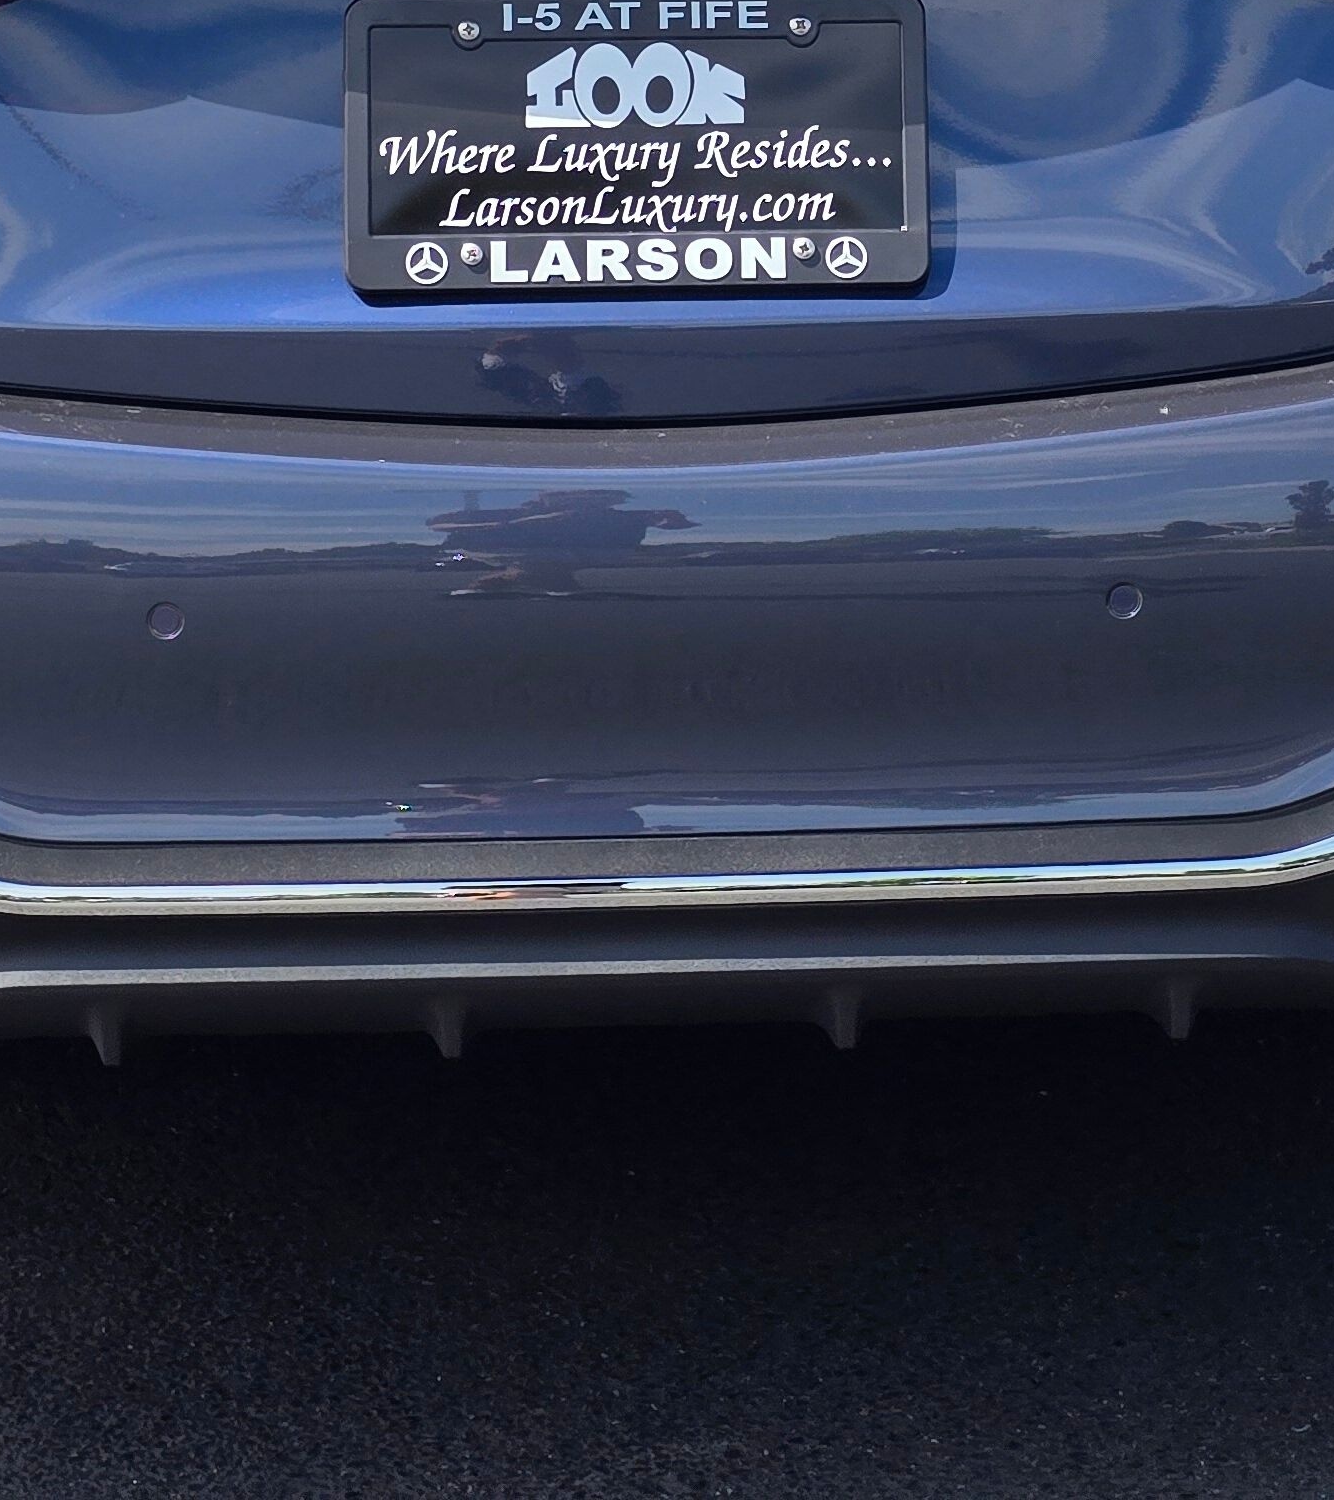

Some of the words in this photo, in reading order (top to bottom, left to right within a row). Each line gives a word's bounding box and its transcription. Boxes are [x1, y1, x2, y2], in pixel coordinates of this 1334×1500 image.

[501, 3, 563, 32] I-5
[574, 2, 641, 31] AT
[658, 0, 769, 30] FIFE
[525, 41, 746, 129] LOOK
[378, 129, 517, 176] Where
[526, 133, 680, 188] Luxury
[693, 124, 893, 179] Resides...
[438, 185, 837, 233] LarsonLuxury.com
[488, 236, 788, 284] LARSON
